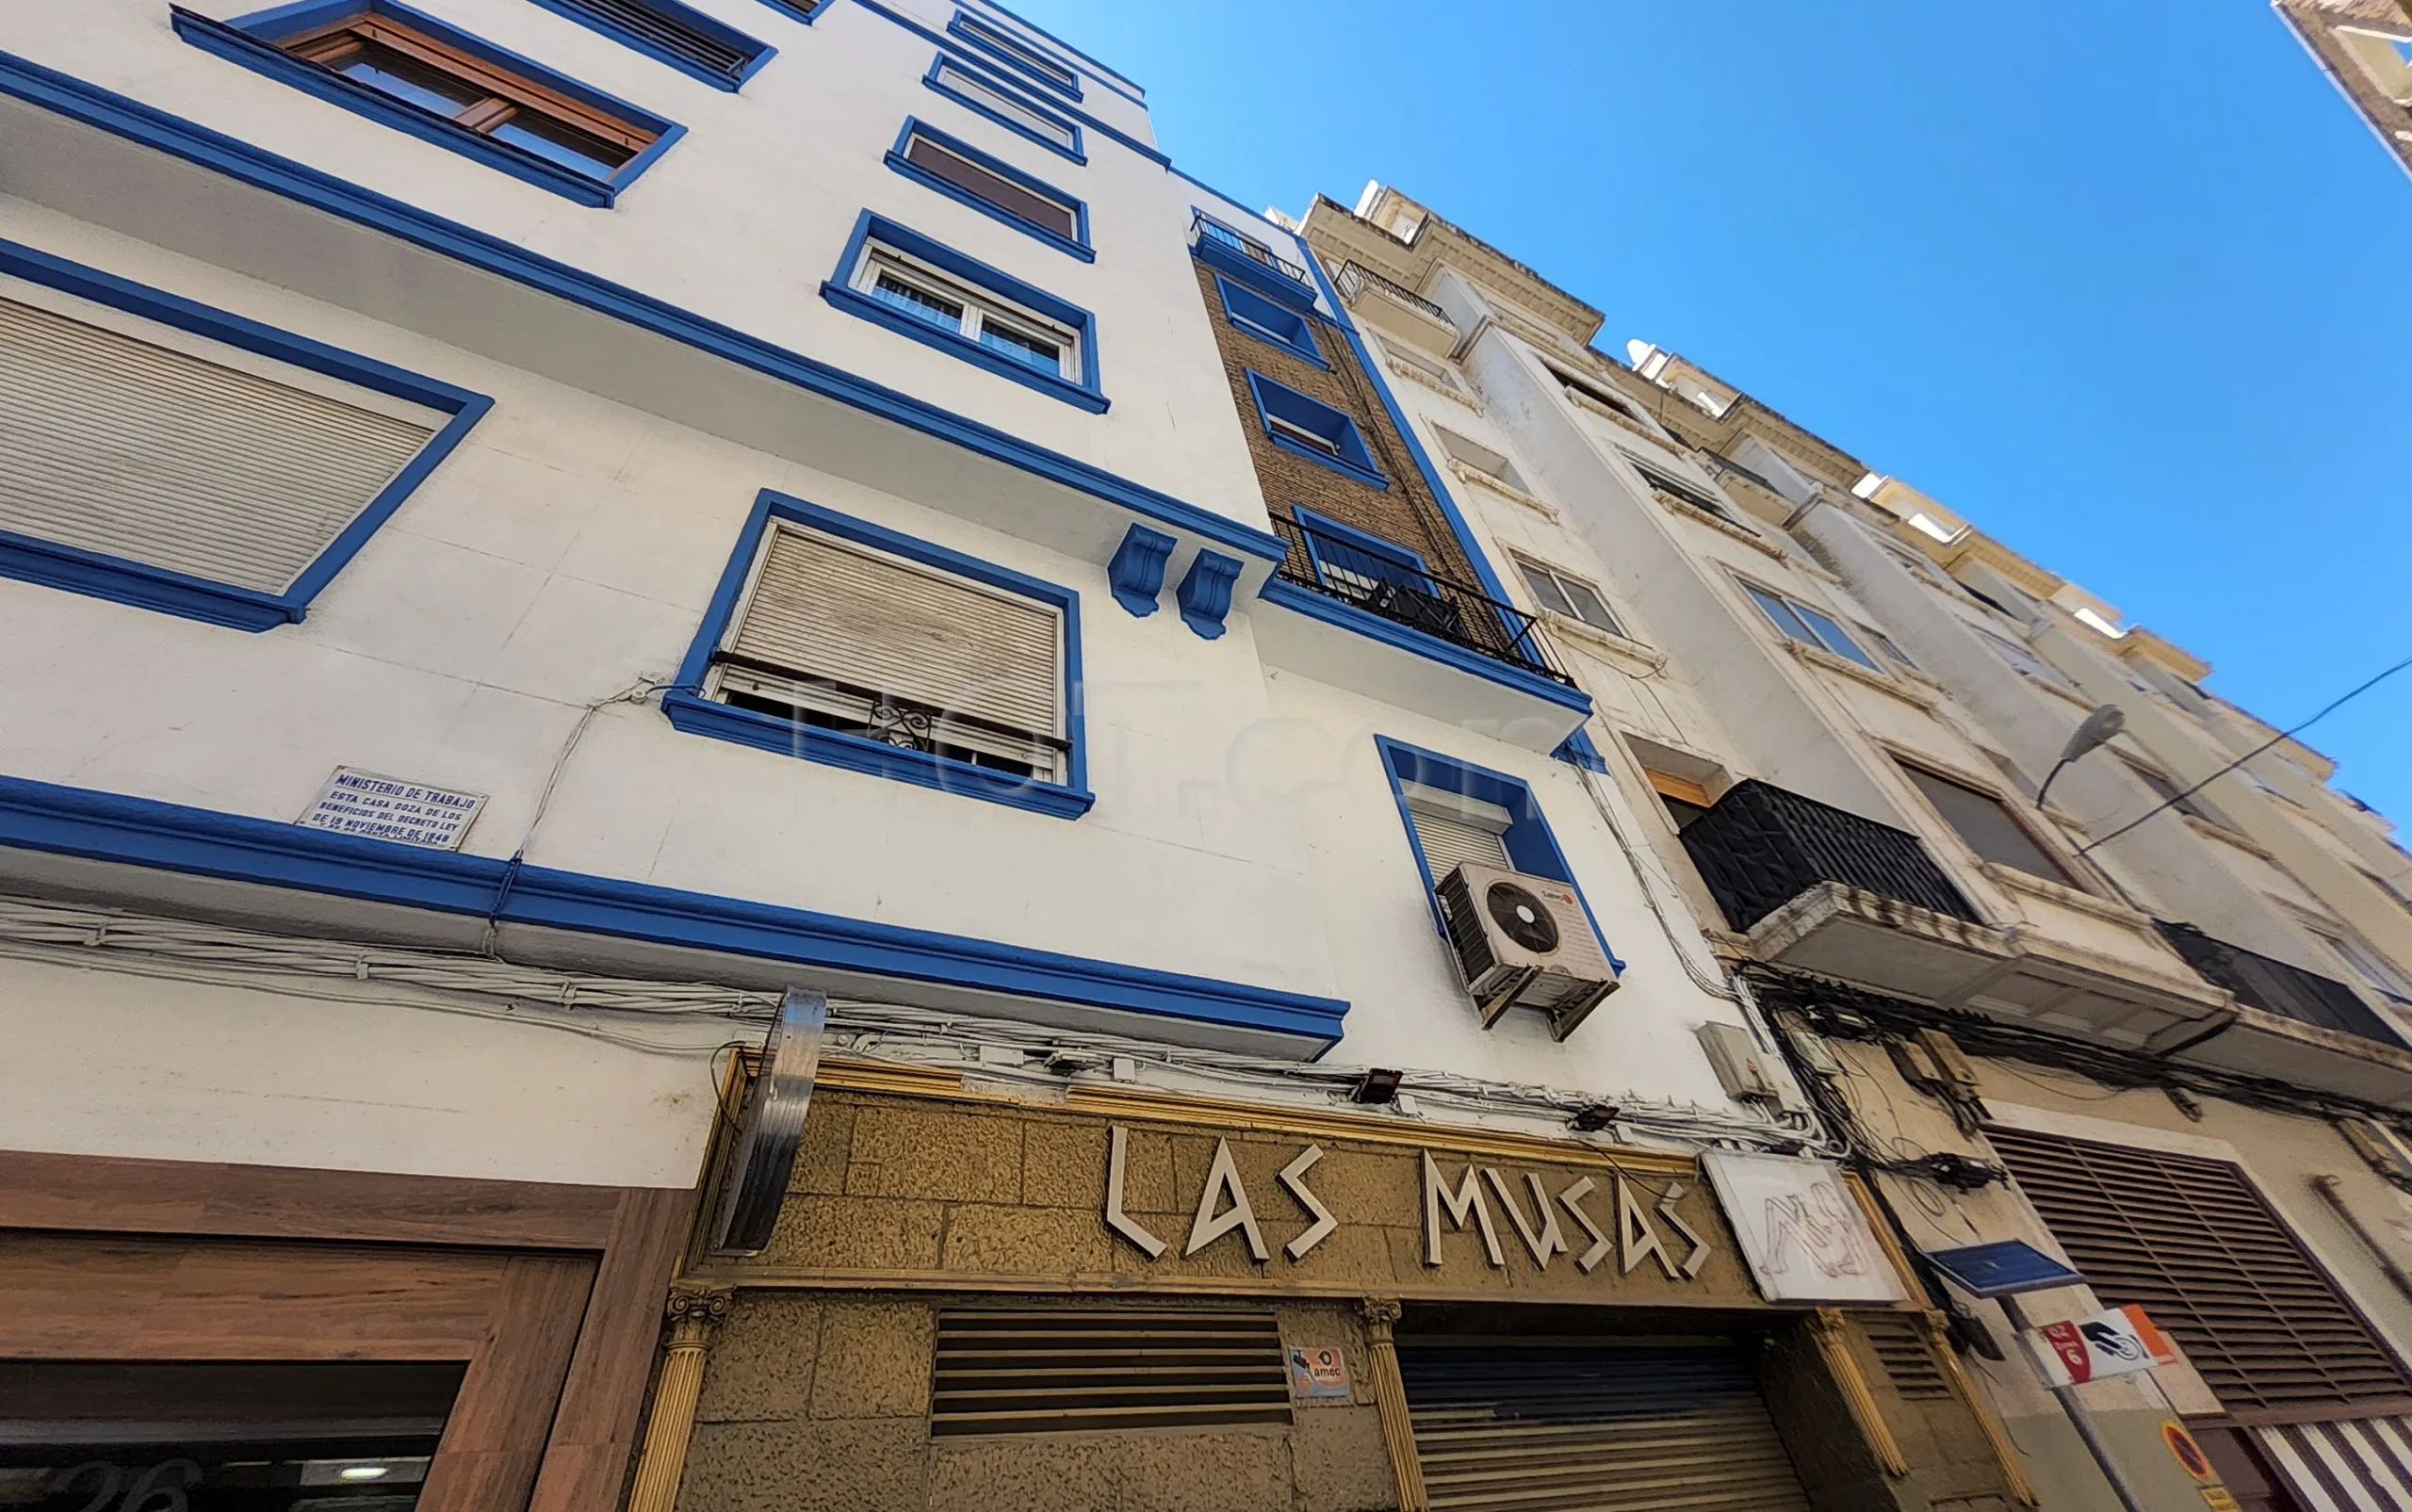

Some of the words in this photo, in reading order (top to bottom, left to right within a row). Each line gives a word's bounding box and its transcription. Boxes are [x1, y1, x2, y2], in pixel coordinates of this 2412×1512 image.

[330, 790, 358, 804] ESTA
[362, 797, 390, 808] CASA
[425, 807, 441, 817] DE
[441, 810, 463, 821] LOS
[335, 773, 405, 796] MINISTERIO
[405, 788, 423, 800] DE
[425, 790, 476, 809] TRABAJO
[312, 813, 329, 822] DE
[330, 816, 344, 825] 19
[344, 819, 406, 836] NOVIEMBRE
[407, 828, 423, 838] DE
[319, 801, 376, 818] BENEFICIOS
[376, 811, 394, 821] DEL
[398, 814, 439, 828] DECRETO
[440, 821, 460, 832] LEY
[1106, 1125, 1339, 1260] LAS
[1423, 1148, 1712, 1279] MUSAS
